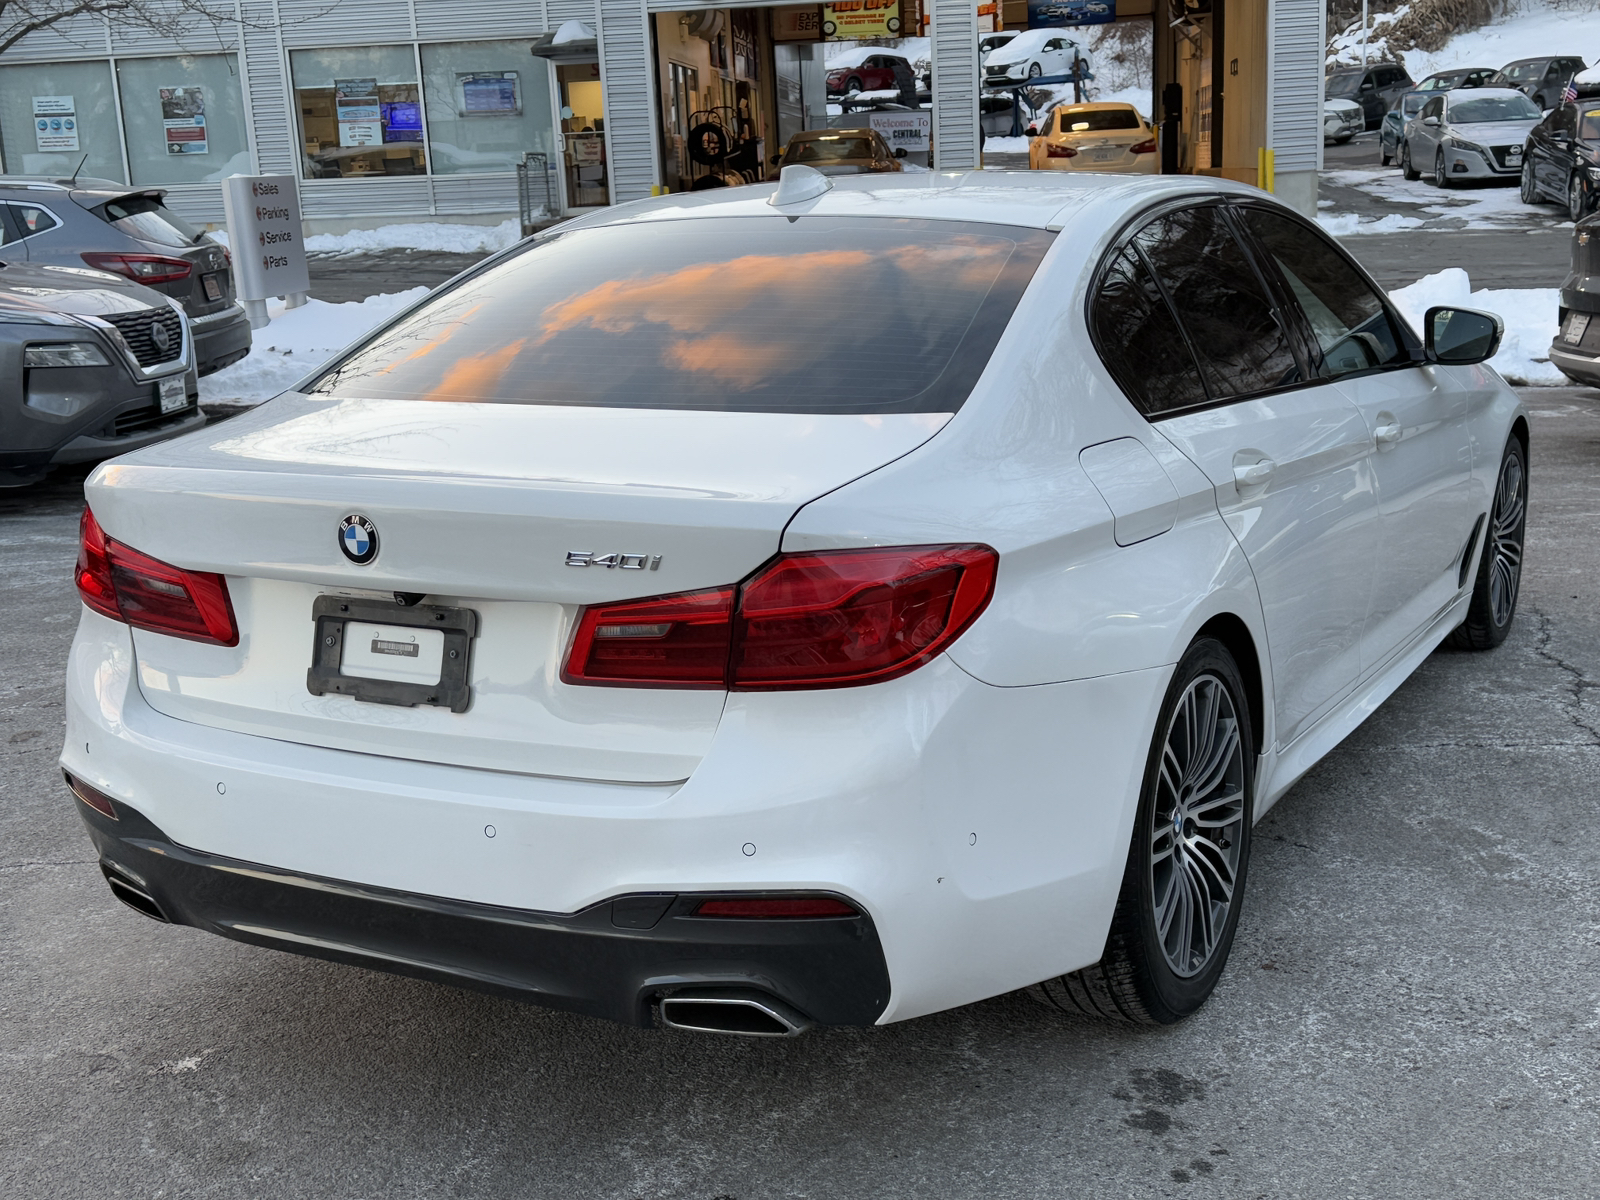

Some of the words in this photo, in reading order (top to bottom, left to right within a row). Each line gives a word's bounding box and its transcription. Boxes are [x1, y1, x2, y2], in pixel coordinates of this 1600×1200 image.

[872, 118, 914, 128] Welcome
[916, 117, 928, 127] To
[893, 129, 921, 139] CENTRAL
[258, 183, 279, 195] Sales
[262, 207, 289, 220] Parking
[265, 231, 292, 244] Service
[268, 255, 288, 268] Parts
[340, 515, 373, 533] BMW
[565, 551, 663, 571] 540i
